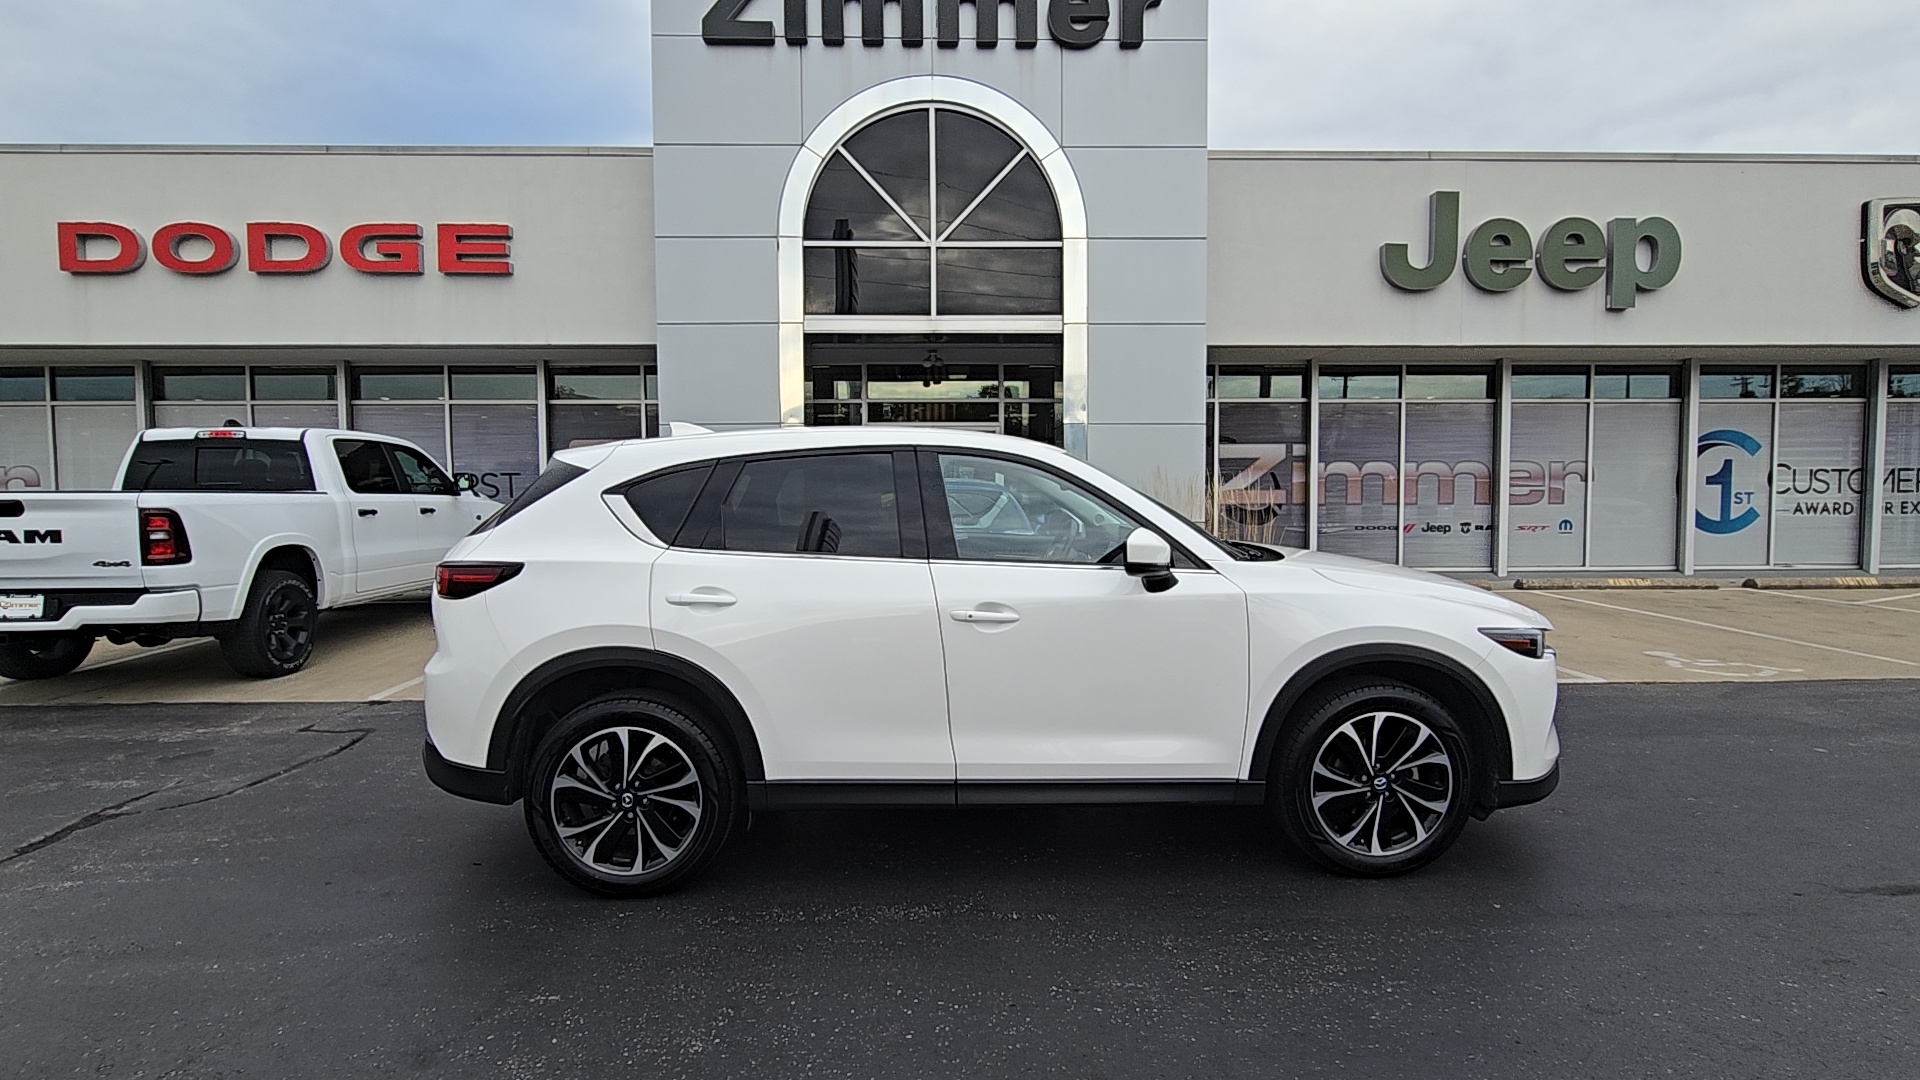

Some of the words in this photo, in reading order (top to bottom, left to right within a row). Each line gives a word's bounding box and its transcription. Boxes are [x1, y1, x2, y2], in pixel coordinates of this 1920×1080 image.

[702, 0, 1162, 49] Zimmer
[57, 221, 514, 276] DODGE
[1380, 190, 1682, 311] Jeep
[1218, 442, 1594, 506] Zimmer
[1767, 463, 1920, 495] CUSTOE
[1421, 521, 1452, 535] Jeep
[1474, 524, 1495, 532] RA
[1514, 525, 1551, 533] SRT
[1792, 501, 1854, 516] AWARD
